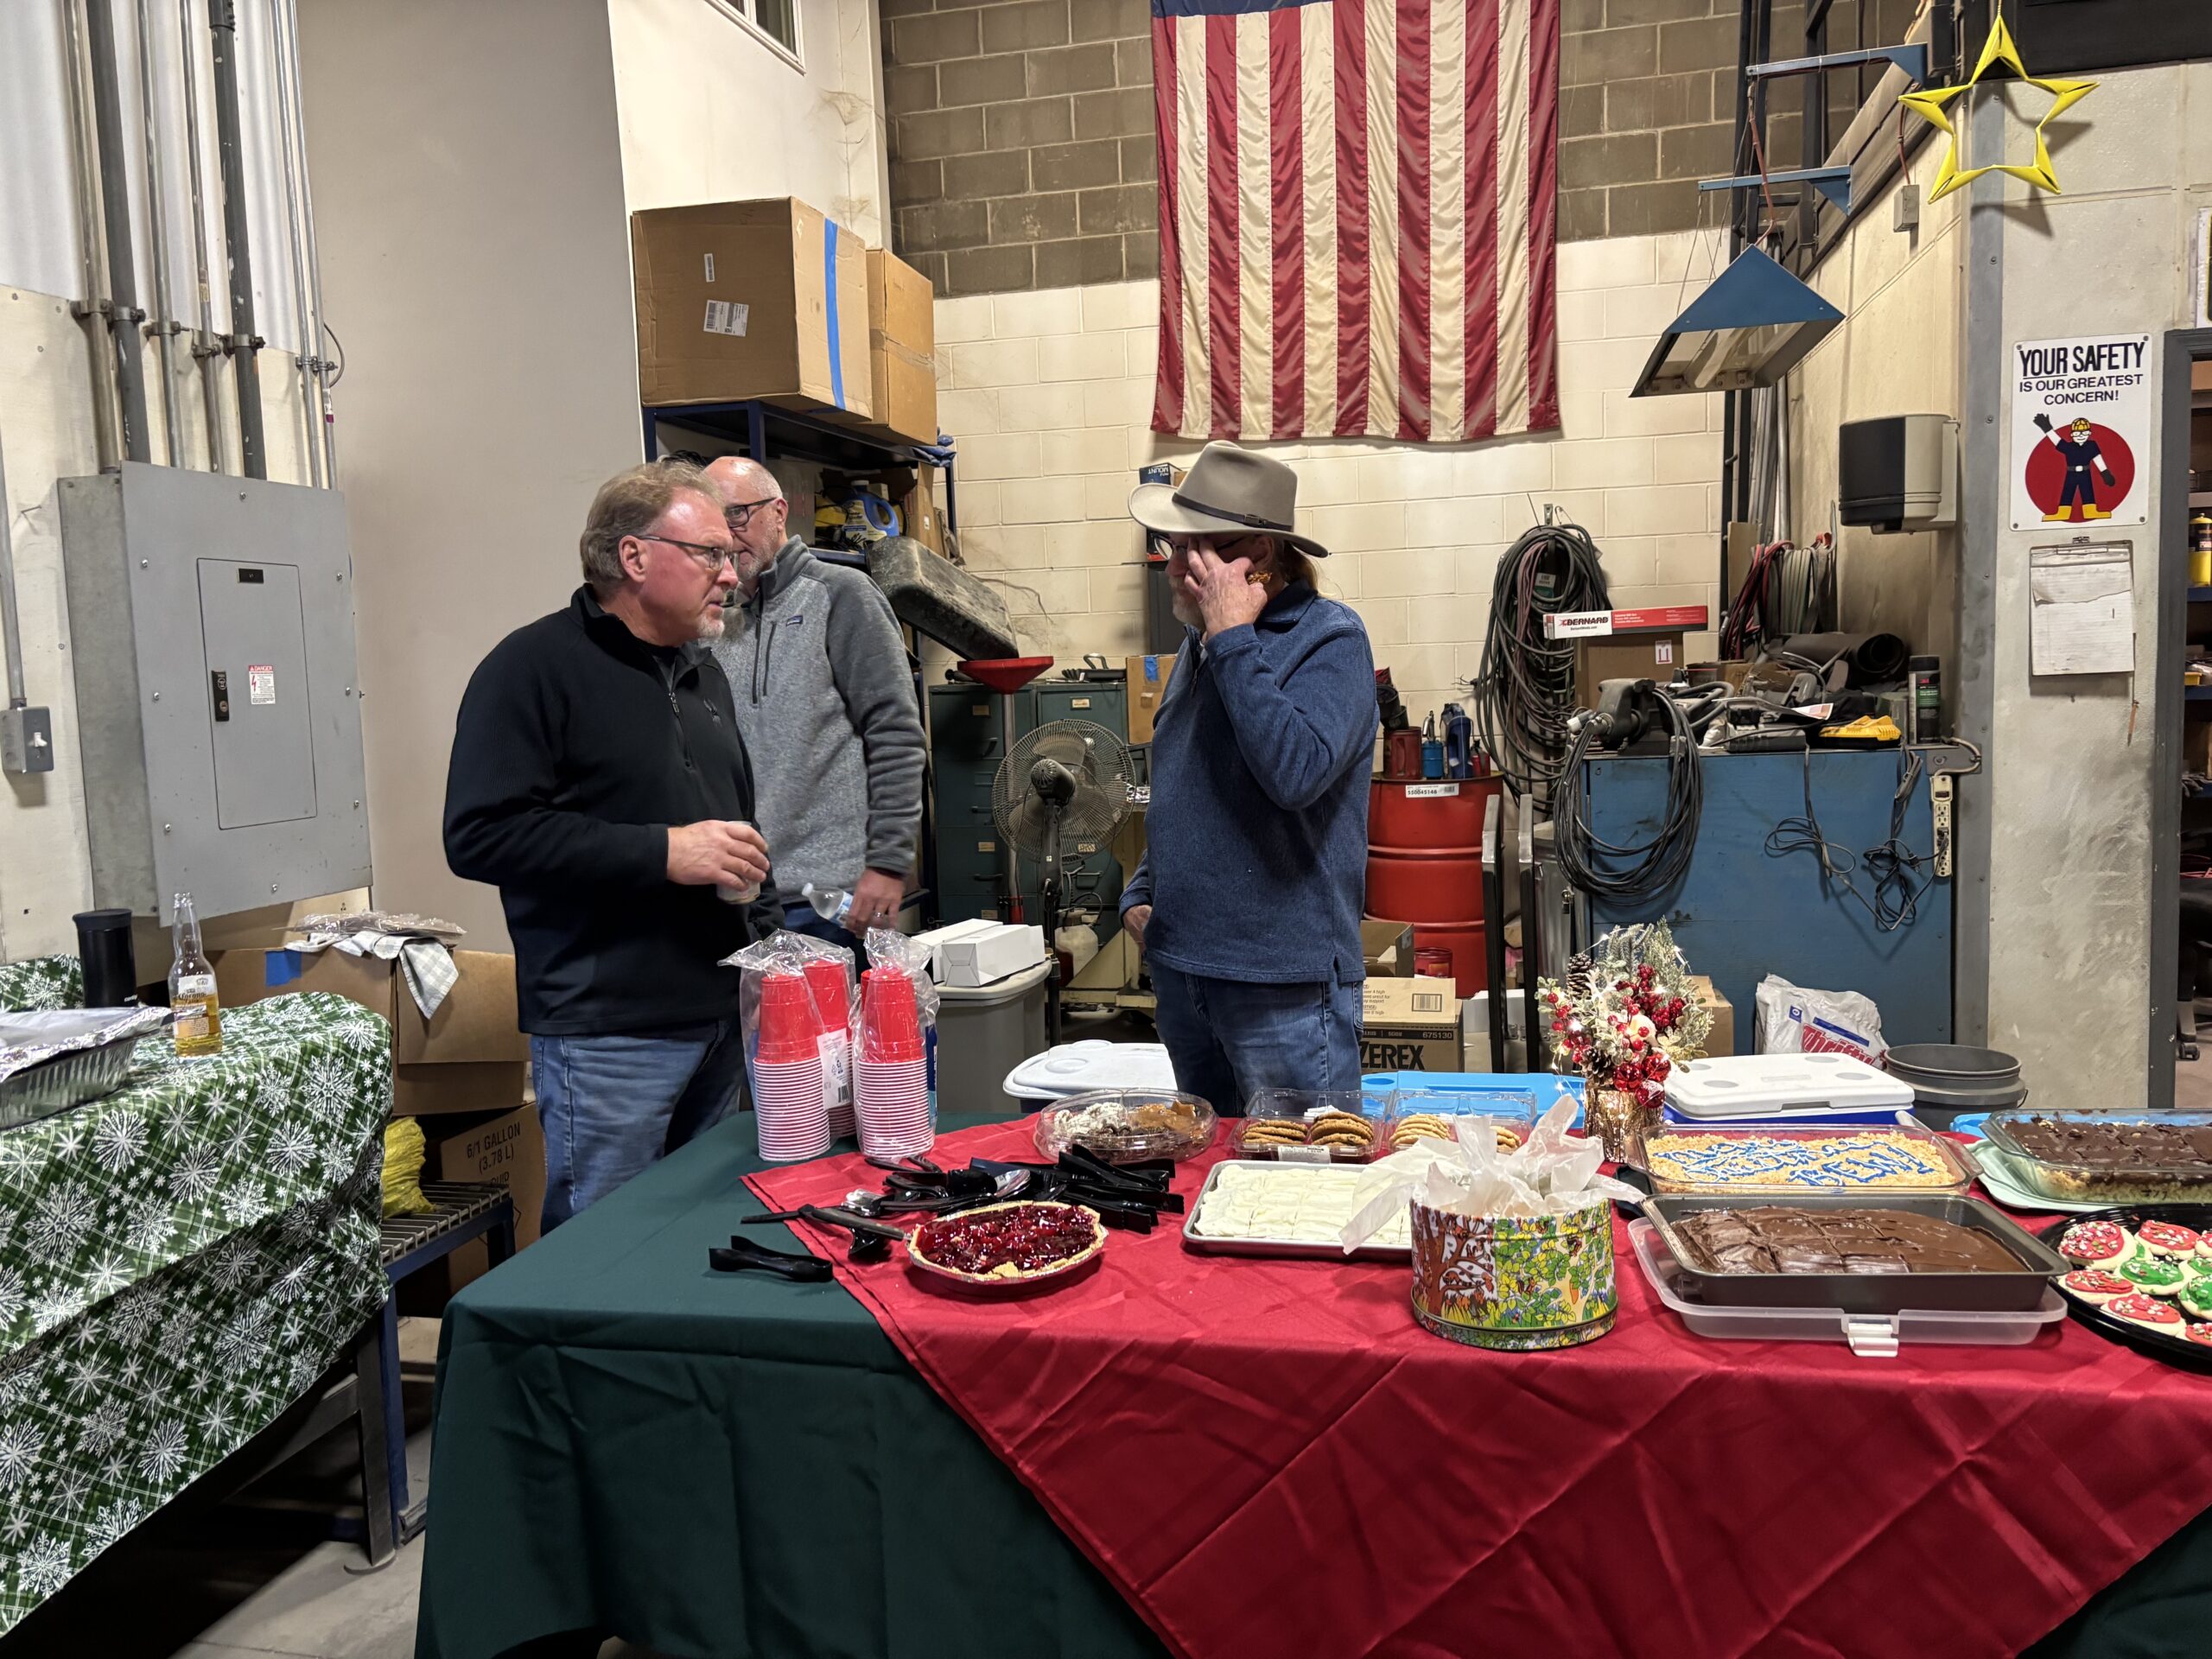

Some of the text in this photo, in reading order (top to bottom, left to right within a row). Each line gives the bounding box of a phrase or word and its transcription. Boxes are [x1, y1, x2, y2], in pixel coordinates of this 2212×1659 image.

[2019, 341, 2145, 377] YOUR SAFETY
[2019, 374, 2144, 392] IS OUR GREATEST
[2044, 390, 2119, 405] CONCERN!
[1567, 616, 1609, 626] BERNARD
[1422, 1031, 1452, 1039] 675130
[1359, 1040, 1425, 1071] ZEREX
[466, 1122, 521, 1159] 6/1 GALLON
[479, 1150, 503, 1175] (3.78
